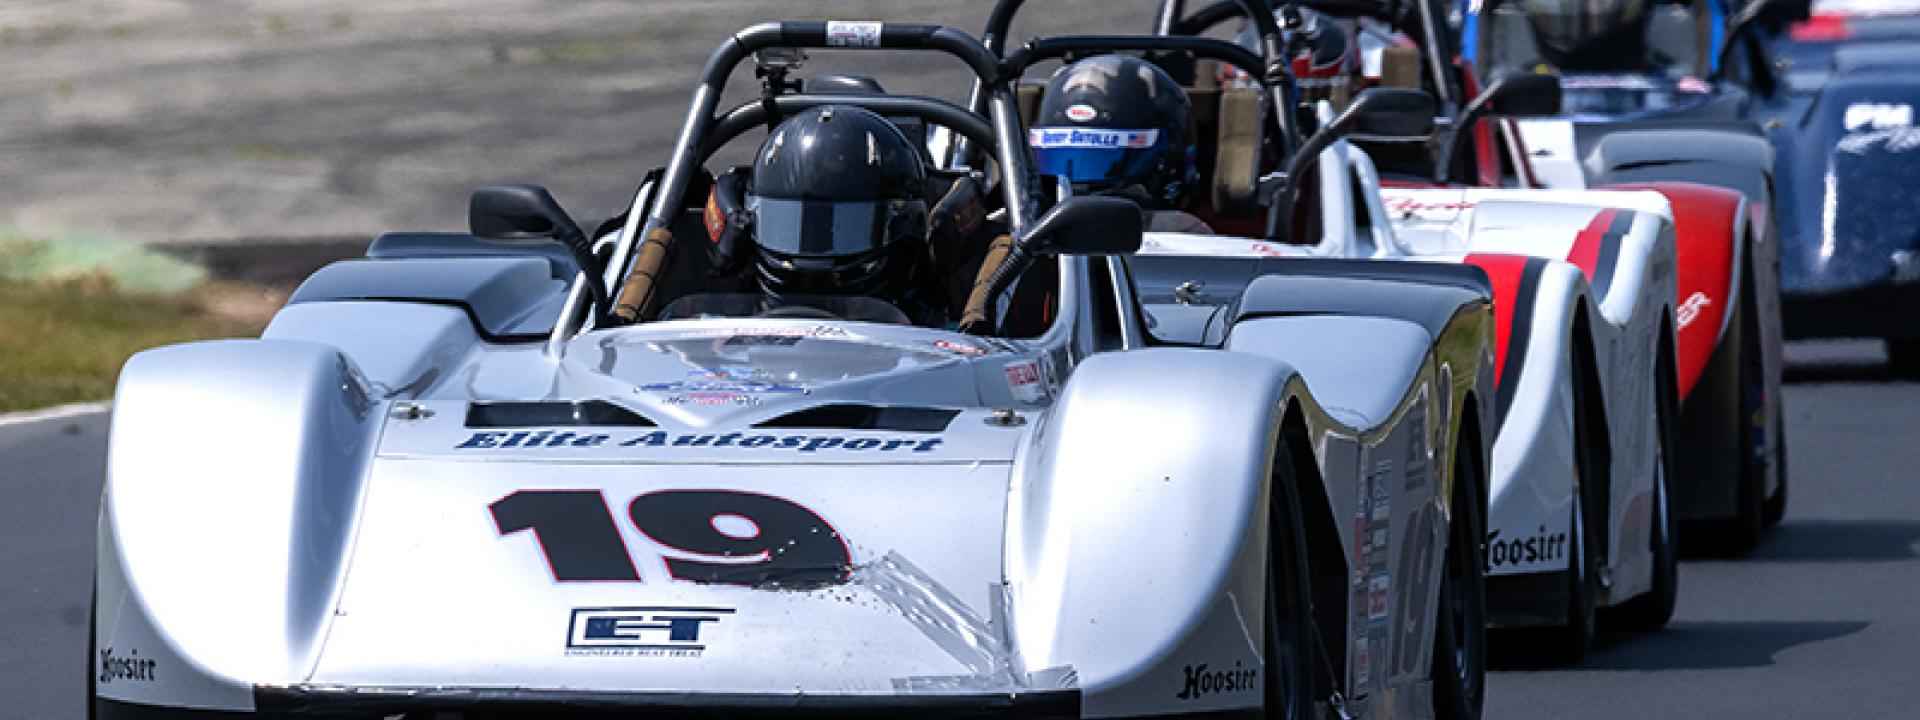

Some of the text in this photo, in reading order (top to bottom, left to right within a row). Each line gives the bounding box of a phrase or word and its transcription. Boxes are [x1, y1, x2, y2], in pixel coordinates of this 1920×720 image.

[455, 431, 942, 452] Elite Autosport
[487, 489, 852, 589] 19
[1176, 660, 1256, 699] Hoosier
